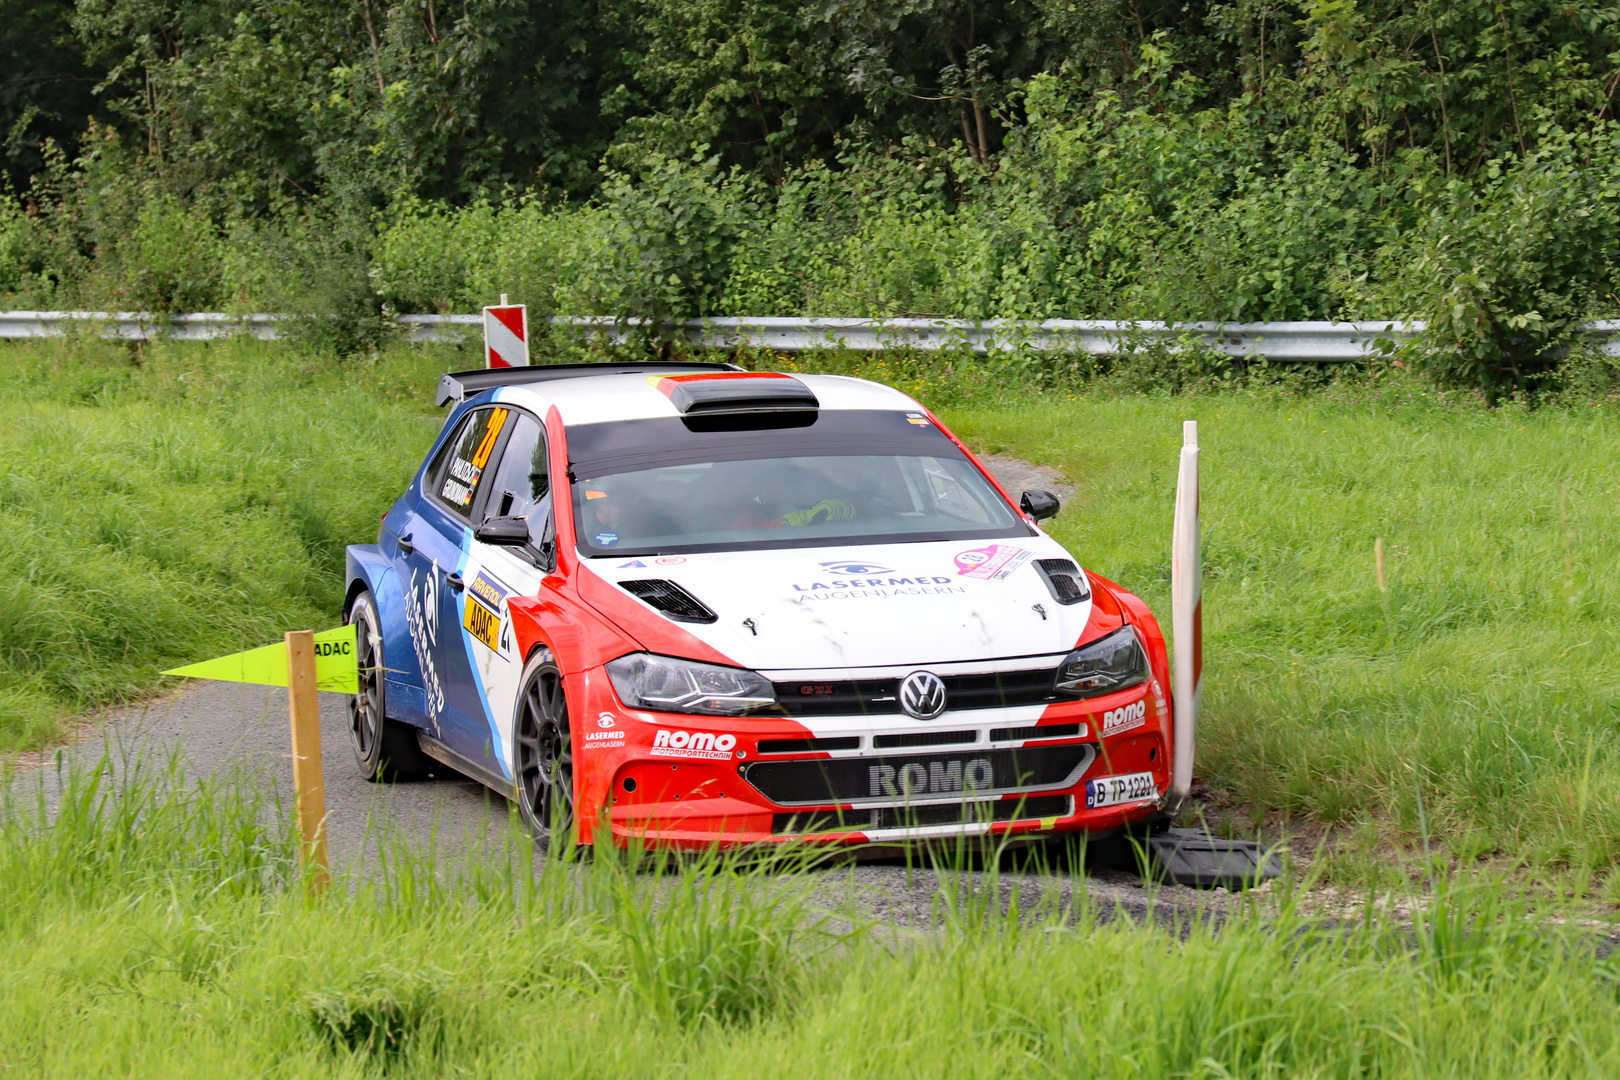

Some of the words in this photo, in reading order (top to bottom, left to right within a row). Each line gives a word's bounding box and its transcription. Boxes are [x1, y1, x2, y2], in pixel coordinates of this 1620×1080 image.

[472, 407, 508, 469] 28
[472, 577, 501, 607] RAVENOL
[792, 576, 952, 591] LASERMED
[800, 587, 966, 602] AUGENLASERN
[470, 603, 493, 645] ADAC
[314, 641, 351, 657] ADAC
[411, 567, 444, 713] LASERMED
[800, 685, 833, 695] GTI
[1104, 699, 1146, 729] ROMO
[584, 741, 626, 750] AUGENLASERN
[586, 731, 625, 741] LASERMED
[653, 730, 737, 752] ROMO
[651, 748, 732, 760] MOTORSPORTTECHNIK
[869, 759, 994, 796] ROMO
[1087, 796, 1095, 806] D
[1097, 783, 1106, 804] B
[1110, 779, 1126, 802] TP
[1128, 775, 1152, 799] 1221
